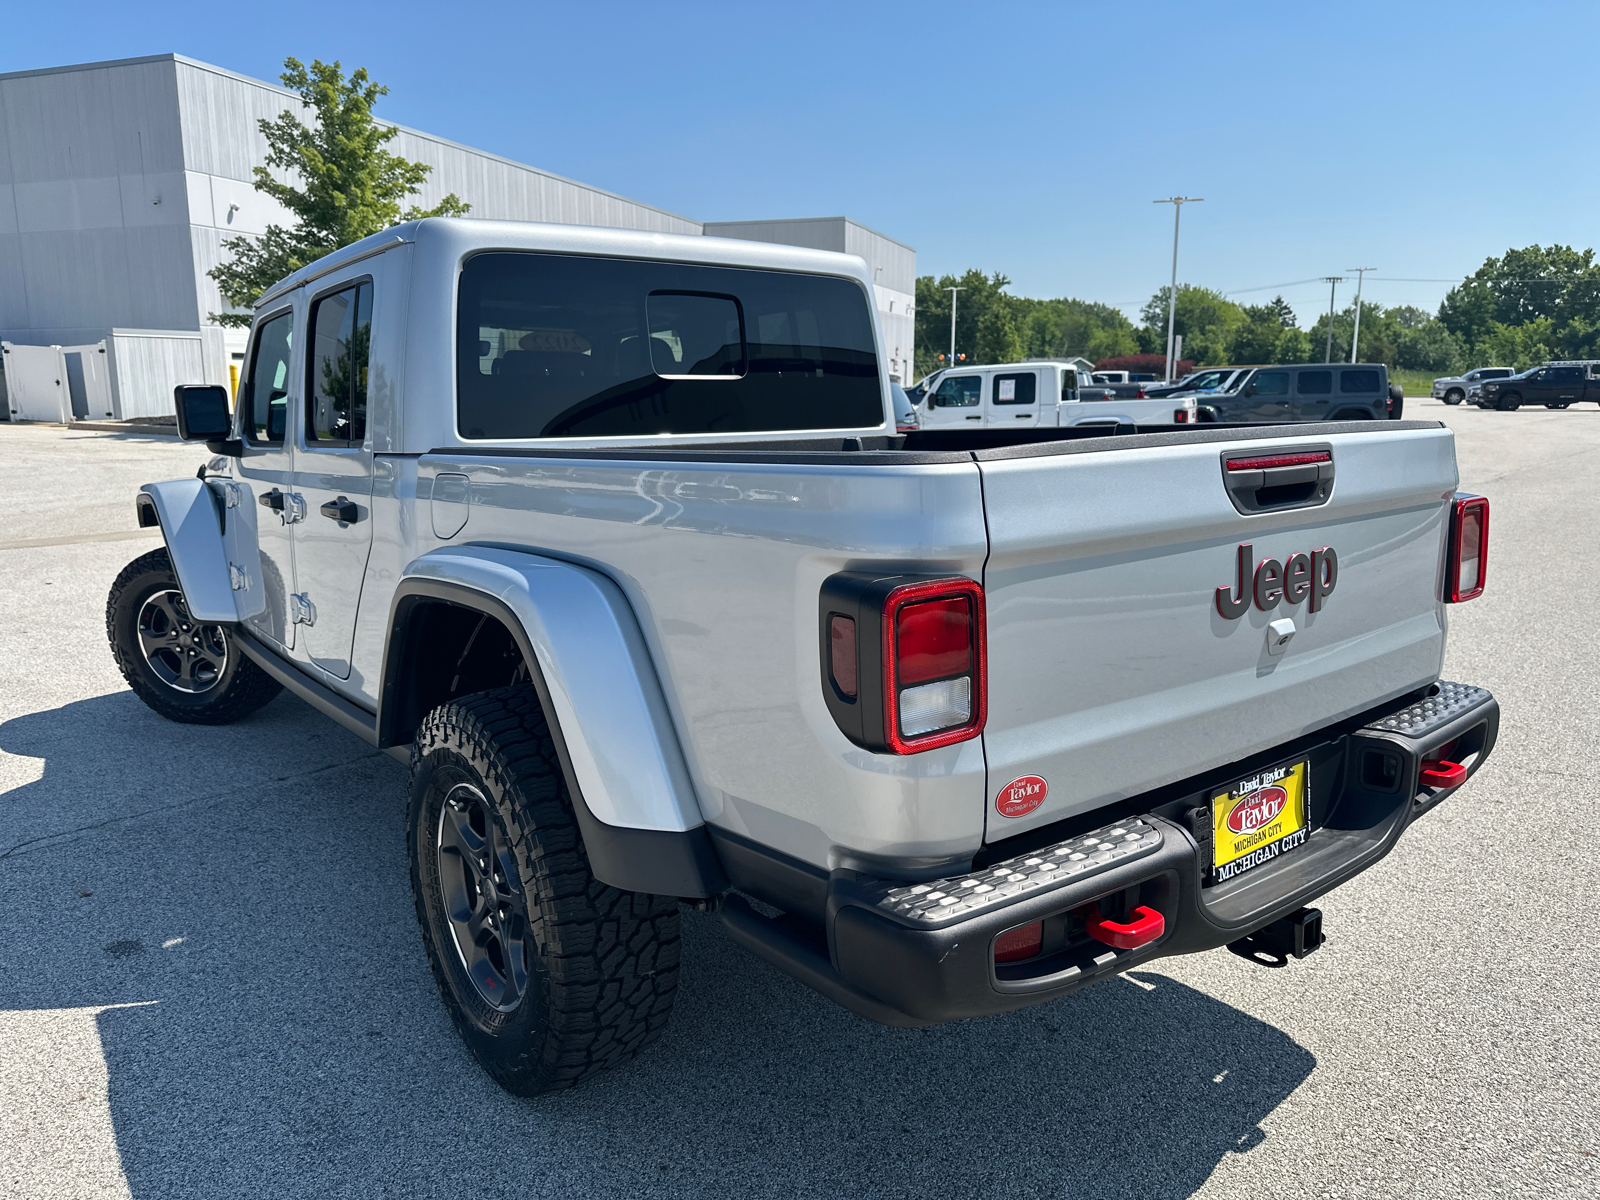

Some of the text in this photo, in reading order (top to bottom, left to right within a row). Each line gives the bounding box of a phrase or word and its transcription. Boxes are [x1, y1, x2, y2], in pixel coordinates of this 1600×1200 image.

[1216, 542, 1338, 620] Jeep
[1007, 782, 1042, 802] Taylor
[1239, 767, 1286, 796] David Taylor
[1236, 796, 1281, 834] Taylor
[1244, 792, 1261, 808] David
[1234, 821, 1283, 854] MICHIGAN CITY
[1218, 828, 1307, 882] MICHIGAN CITY
